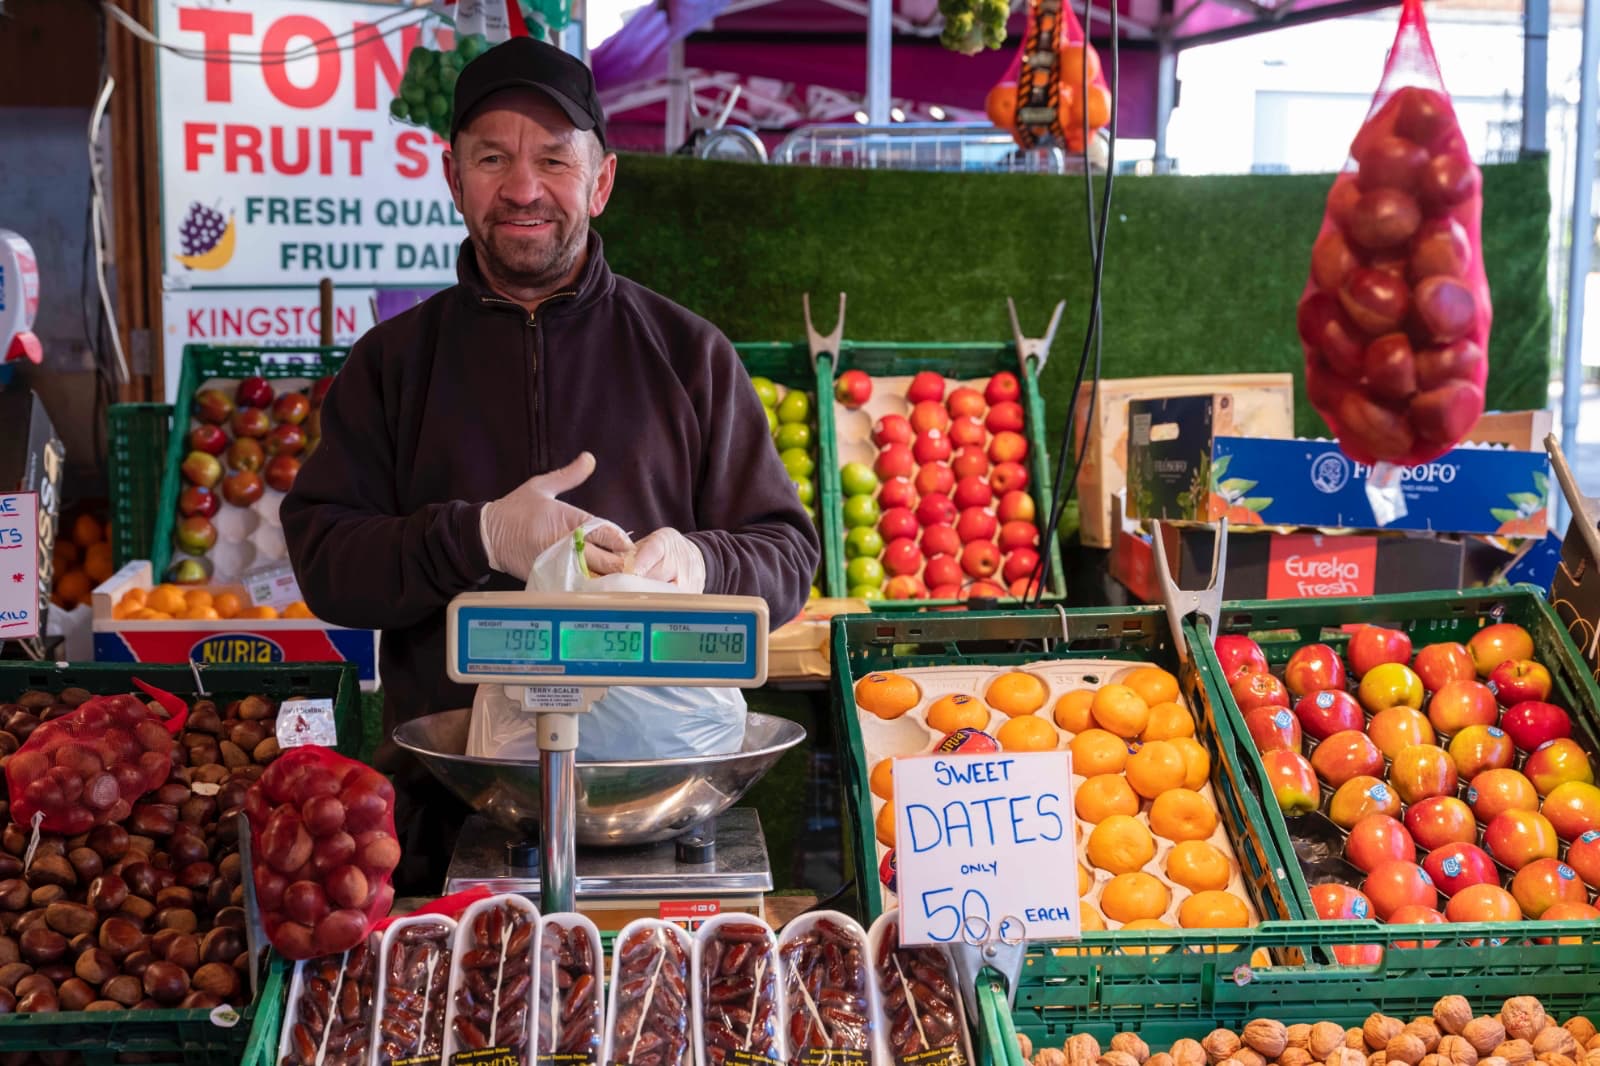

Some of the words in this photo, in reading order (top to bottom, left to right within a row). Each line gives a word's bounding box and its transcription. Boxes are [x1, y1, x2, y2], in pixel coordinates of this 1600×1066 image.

[178, 7, 440, 110] TON
[184, 122, 373, 176] FRUIT
[246, 197, 361, 226] FRESH
[280, 243, 383, 270] FRUIT
[1353, 461, 1456, 483] FISOFO
[1285, 555, 1359, 579] Eureka
[1296, 578, 1358, 597] fresh
[699, 632, 743, 654] 10.48
[934, 760, 1014, 786] SWEET
[906, 793, 1063, 852] DATES
[960, 861, 998, 876] ONLY
[1024, 907, 1070, 922] EACH
